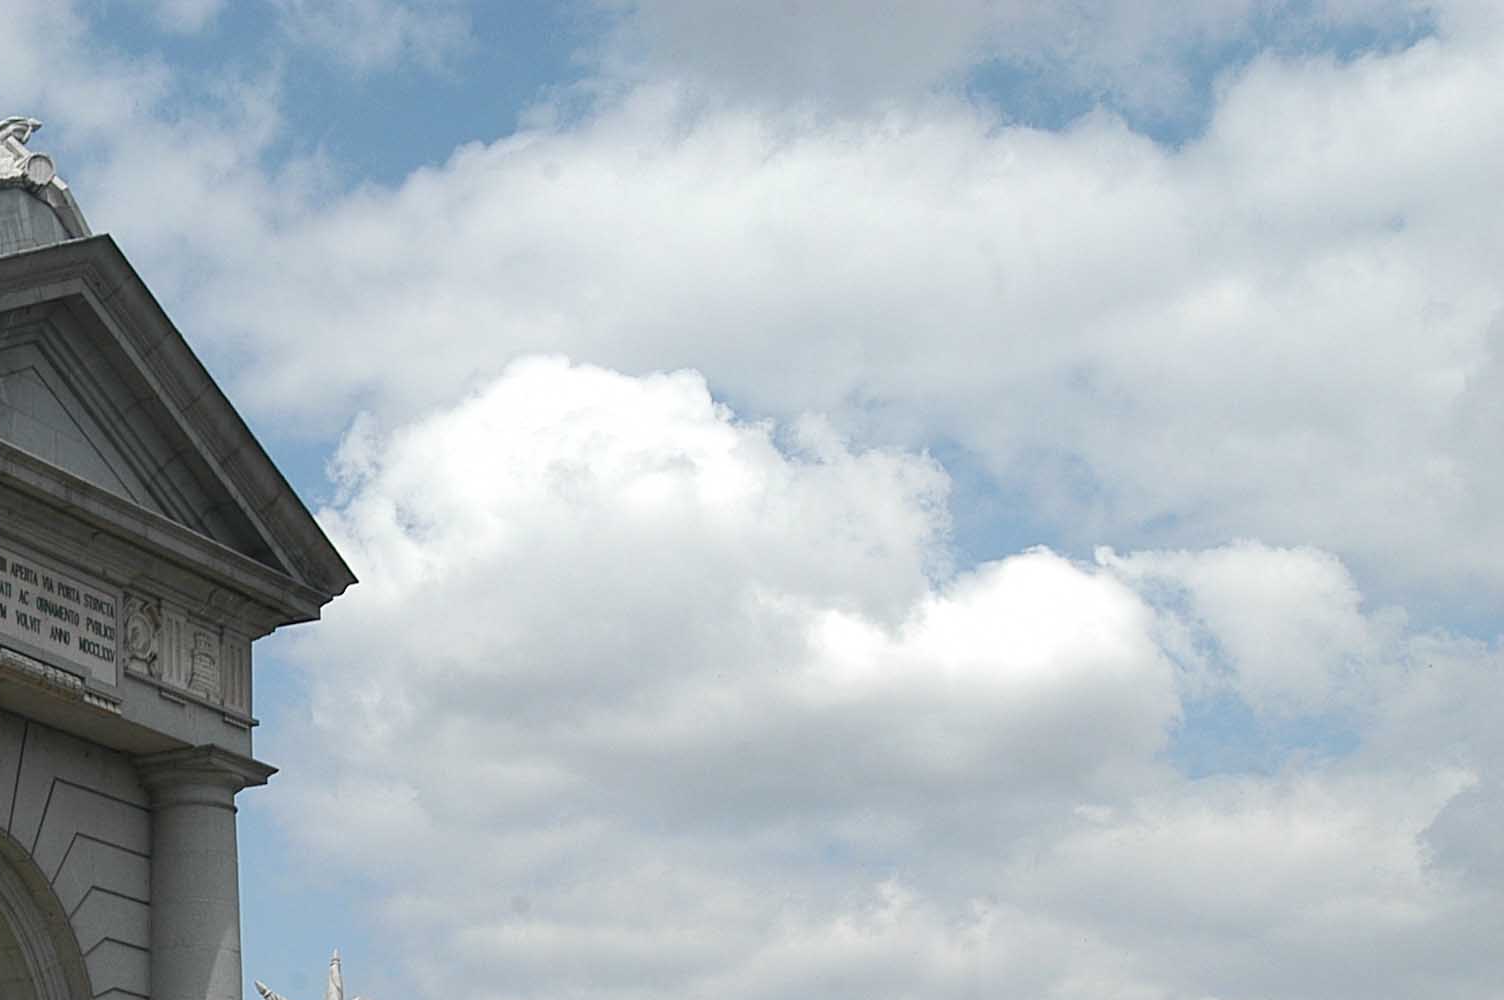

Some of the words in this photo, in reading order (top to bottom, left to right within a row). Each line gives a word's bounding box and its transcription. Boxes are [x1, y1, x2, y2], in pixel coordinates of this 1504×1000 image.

[10, 562, 39, 586] APERTA
[42, 575, 54, 593] VIA
[57, 582, 81, 605] PORTA
[18, 589, 29, 606] AC
[15, 610, 41, 634] VOLVIT
[49, 625, 71, 646] ANNO
